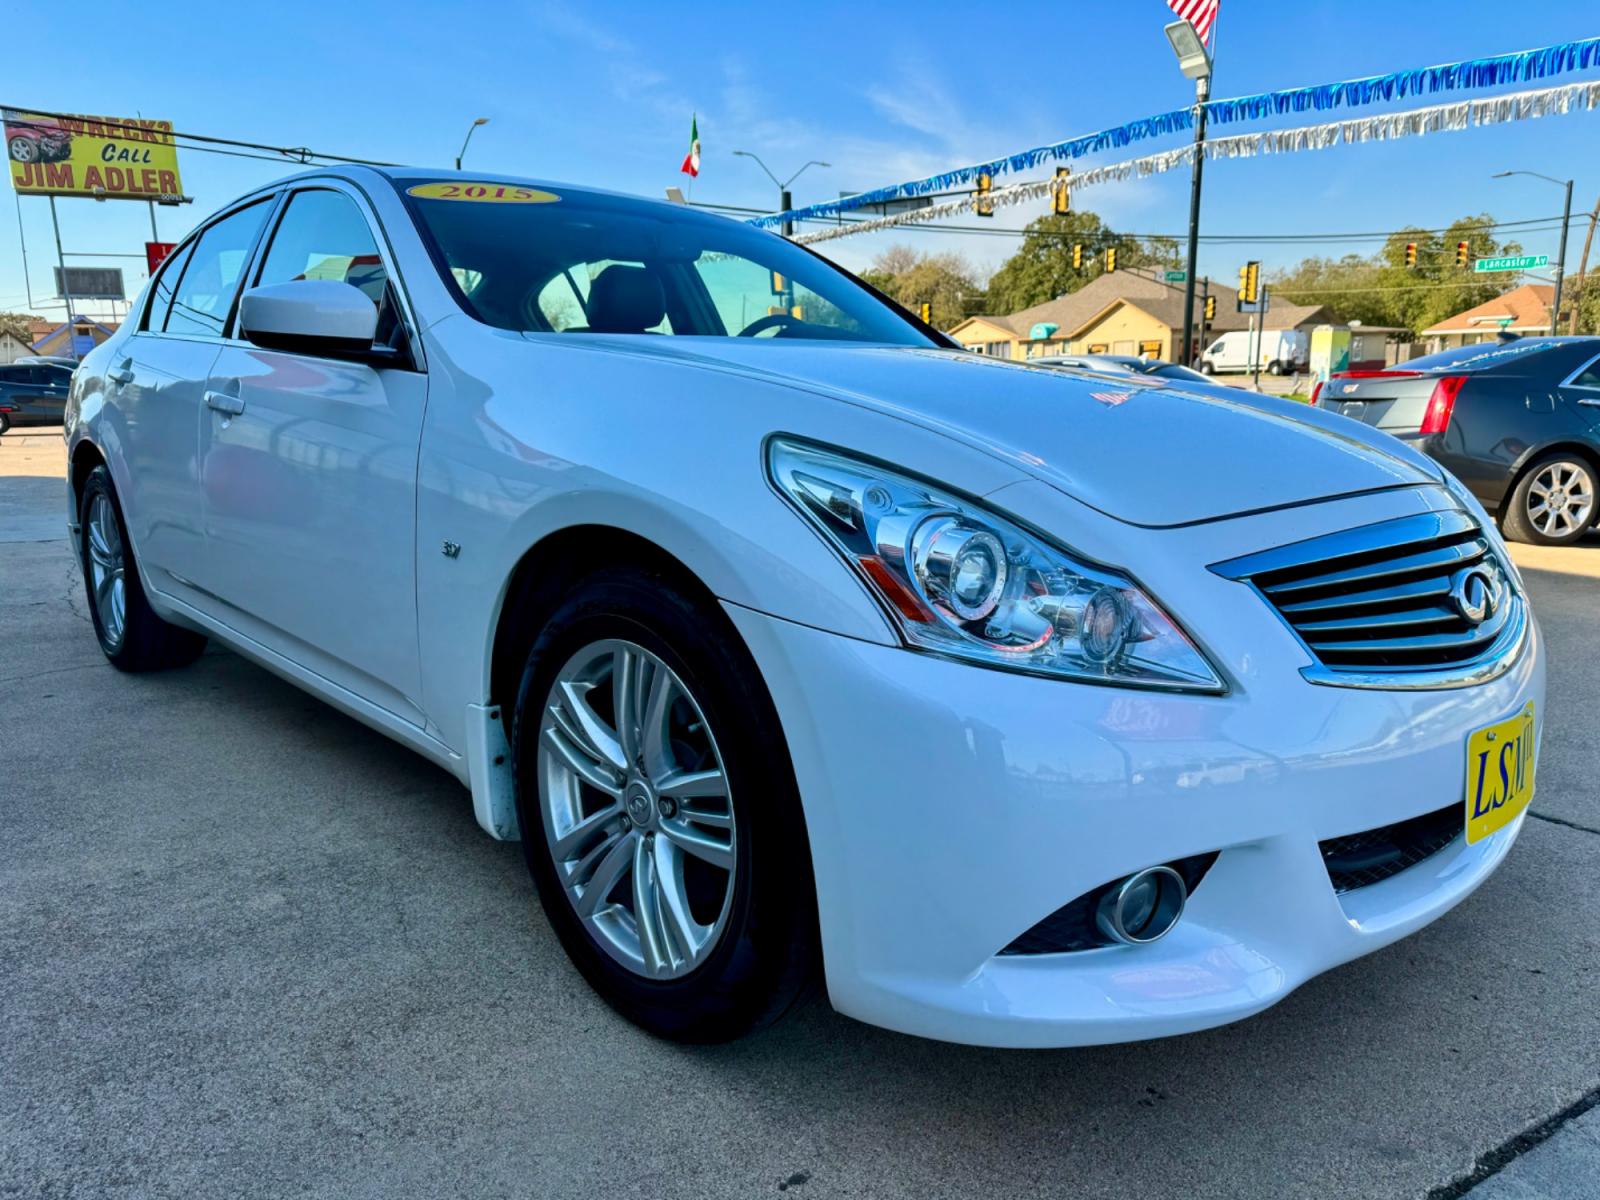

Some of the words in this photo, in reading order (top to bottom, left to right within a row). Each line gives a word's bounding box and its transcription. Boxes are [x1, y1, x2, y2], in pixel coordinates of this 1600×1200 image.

[58, 115, 170, 143] WRECK?
[101, 143, 151, 163] CALL
[16, 162, 75, 188] JIM
[84, 165, 177, 194] ADLER
[440, 185, 532, 199] 2015
[1484, 259, 1530, 269] Lancaster
[1535, 255, 1547, 265] Av
